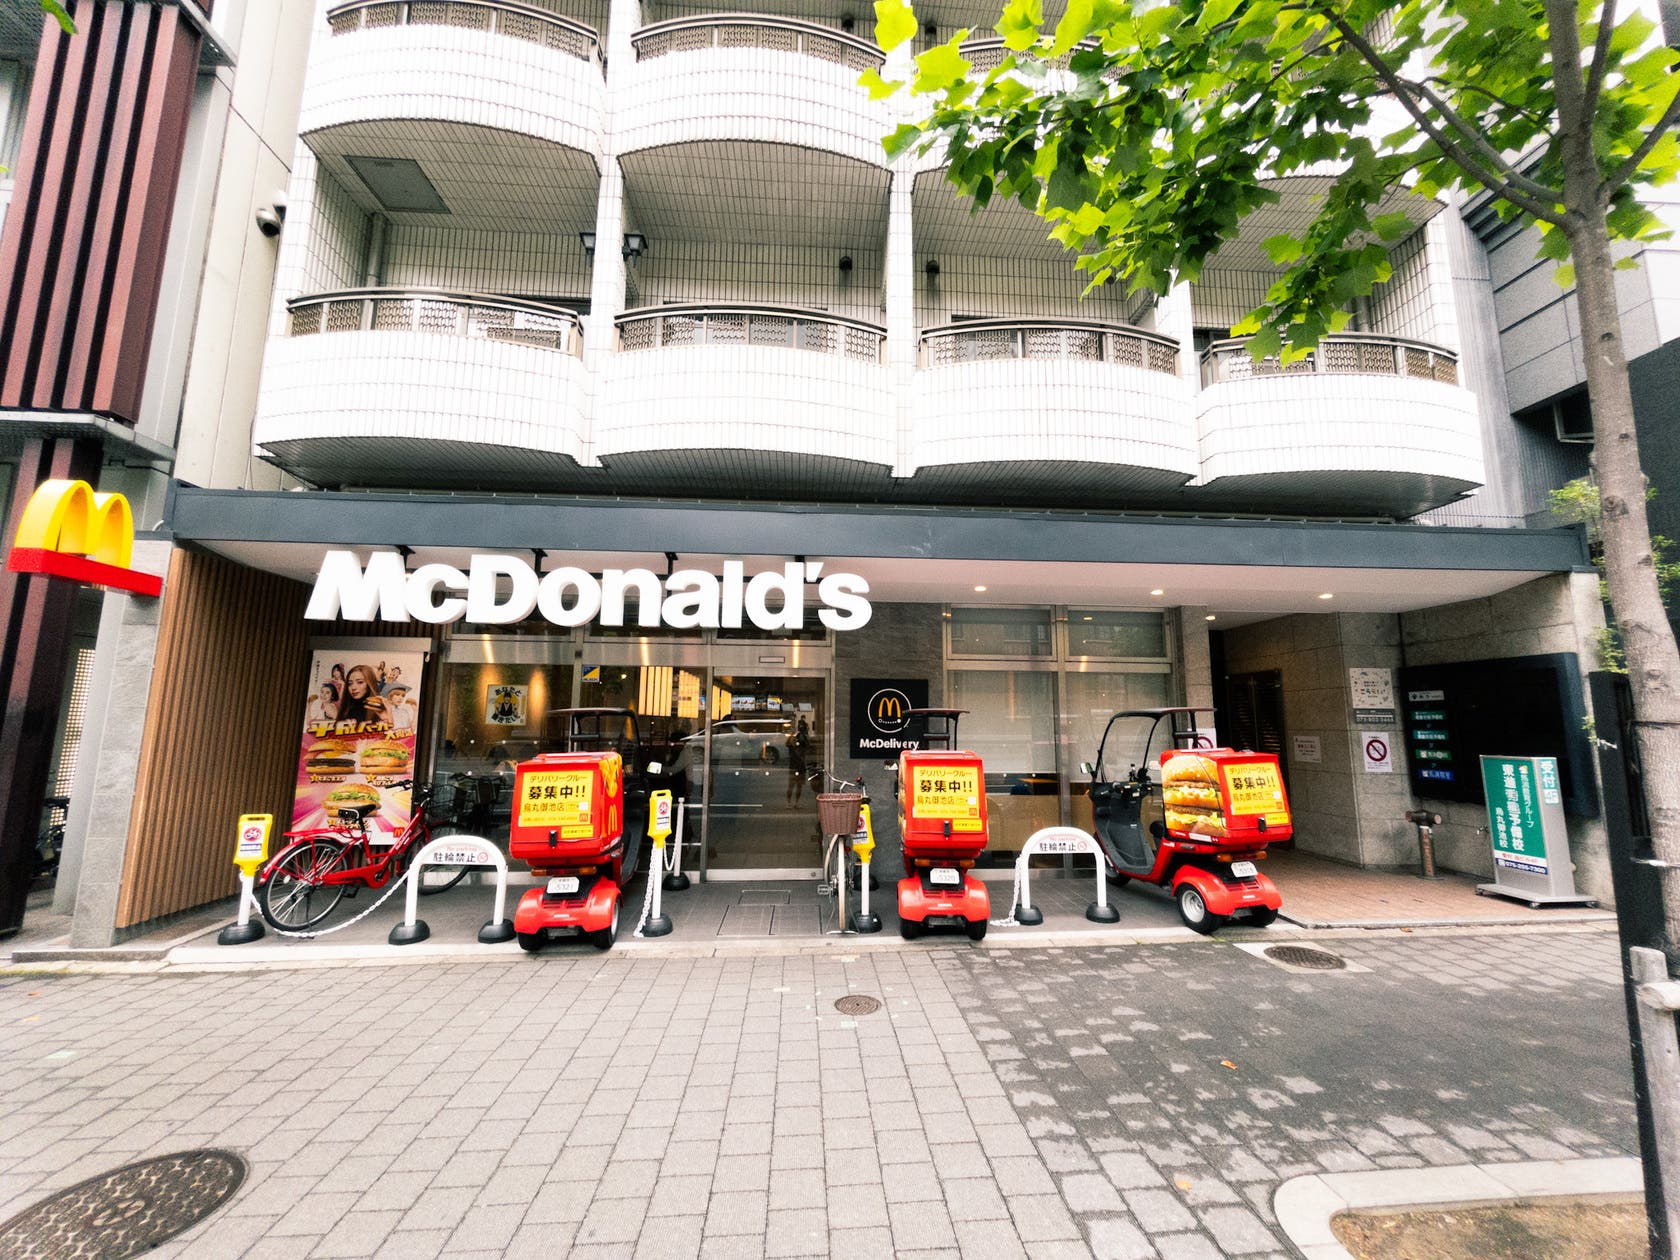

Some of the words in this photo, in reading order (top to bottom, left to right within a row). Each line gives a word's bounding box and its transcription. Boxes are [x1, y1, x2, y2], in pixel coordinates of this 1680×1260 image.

[304, 550, 873, 631] McDonald's
[919, 769, 973, 777] デリバリークルー
[1540, 760, 1556, 788] 受付
[529, 775, 588, 783] デリバリークルー
[1039, 842, 1076, 852] 駐輪禁止
[433, 852, 476, 863] 駐輪禁止
